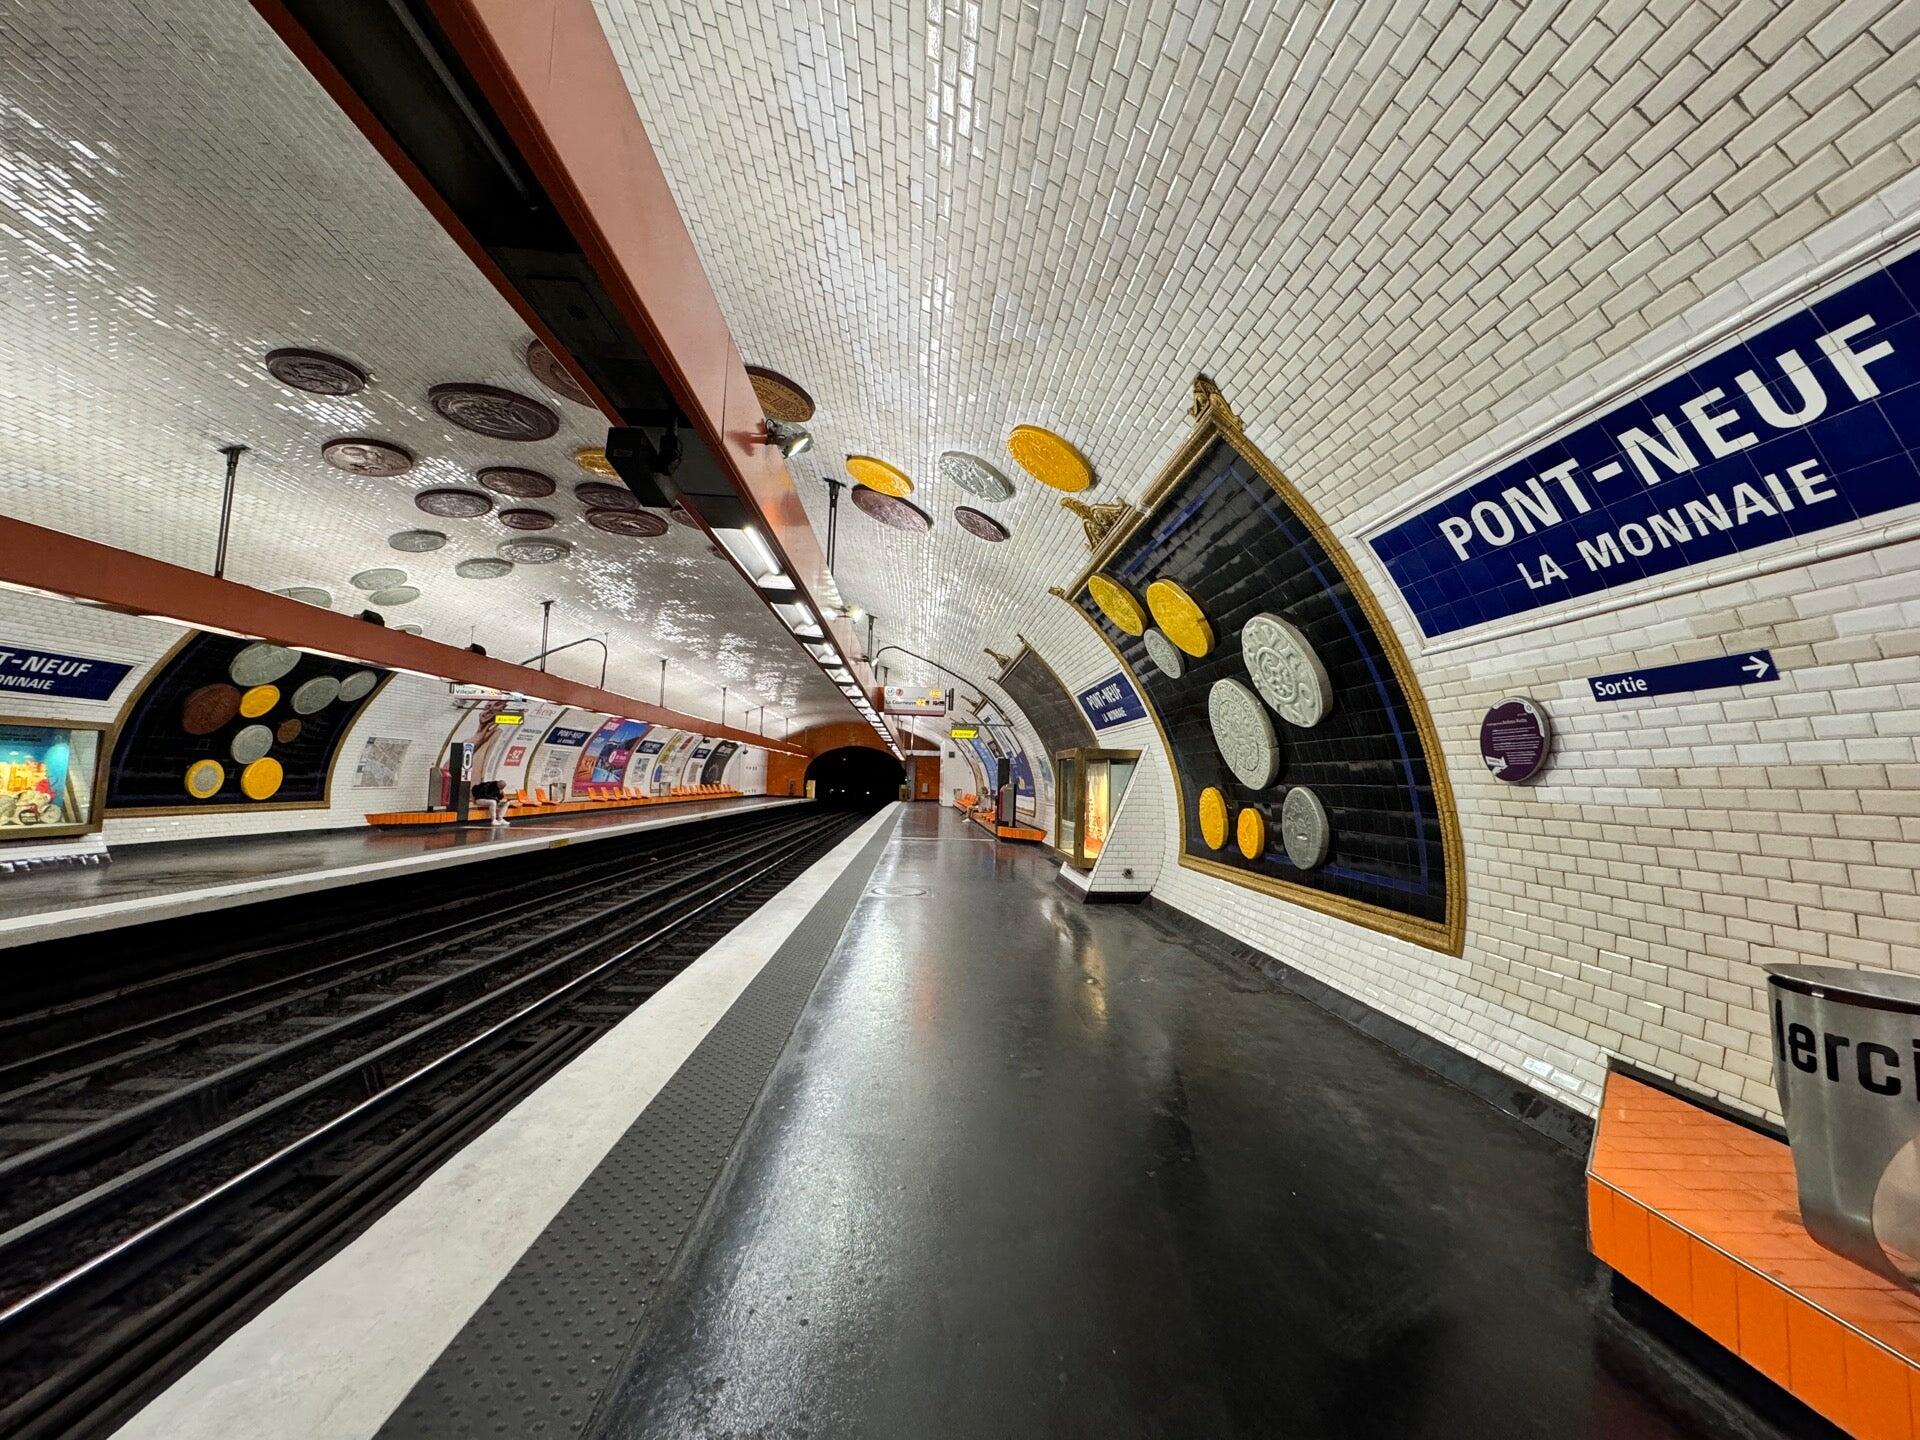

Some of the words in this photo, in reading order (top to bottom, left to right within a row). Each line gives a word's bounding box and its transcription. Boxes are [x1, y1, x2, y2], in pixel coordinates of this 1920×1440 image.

[1438, 313, 1895, 561] PONT-NEUF
[1516, 553, 1569, 590] LA
[1575, 458, 1838, 572] MONNAIE
[1085, 682, 1123, 711] PONT-NEUF
[1594, 676, 1648, 697] Sortie
